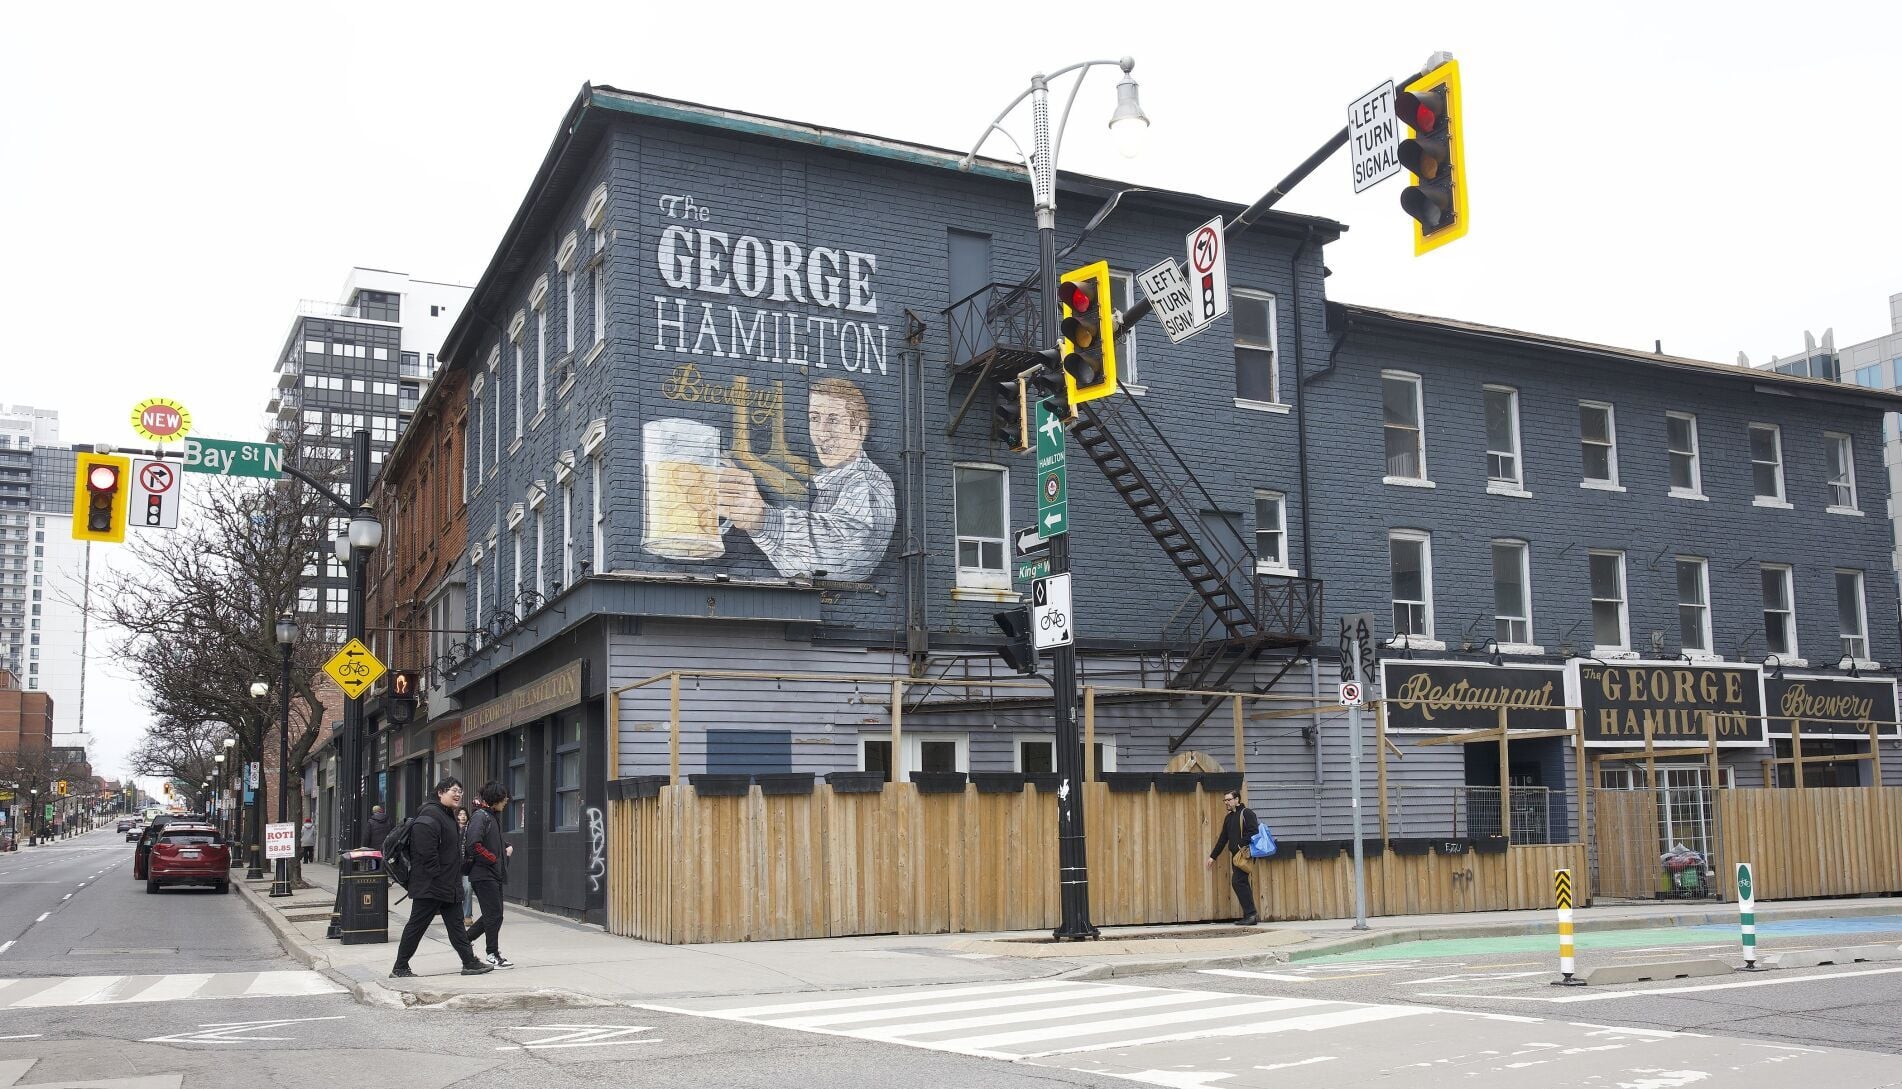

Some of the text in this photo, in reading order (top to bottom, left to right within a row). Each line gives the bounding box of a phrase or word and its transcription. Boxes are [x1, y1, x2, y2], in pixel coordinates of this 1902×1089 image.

[1355, 92, 1387, 129] LEFT
[1356, 118, 1393, 156] TURN
[1356, 146, 1398, 183] SIGNAL
[659, 195, 710, 221] The
[657, 225, 878, 314] GEORGE
[1146, 268, 1176, 295] LEFT
[1156, 287, 1192, 315] TURN
[653, 295, 889, 376] HAMILTON
[1166, 310, 1193, 335] SIGNA
[143, 411, 180, 429] NEW
[184, 440, 283, 475] Bay St N
[1039, 451, 1064, 468] HAMILTON
[1019, 565, 1037, 579] King
[1037, 562, 1043, 570] St
[1398, 672, 1553, 721] Restaurant
[1582, 667, 1743, 704] The GEORGE
[1600, 707, 1748, 736] HAMILTON
[1781, 683, 1873, 733] Brewery
[267, 831, 294, 839] ROTI
